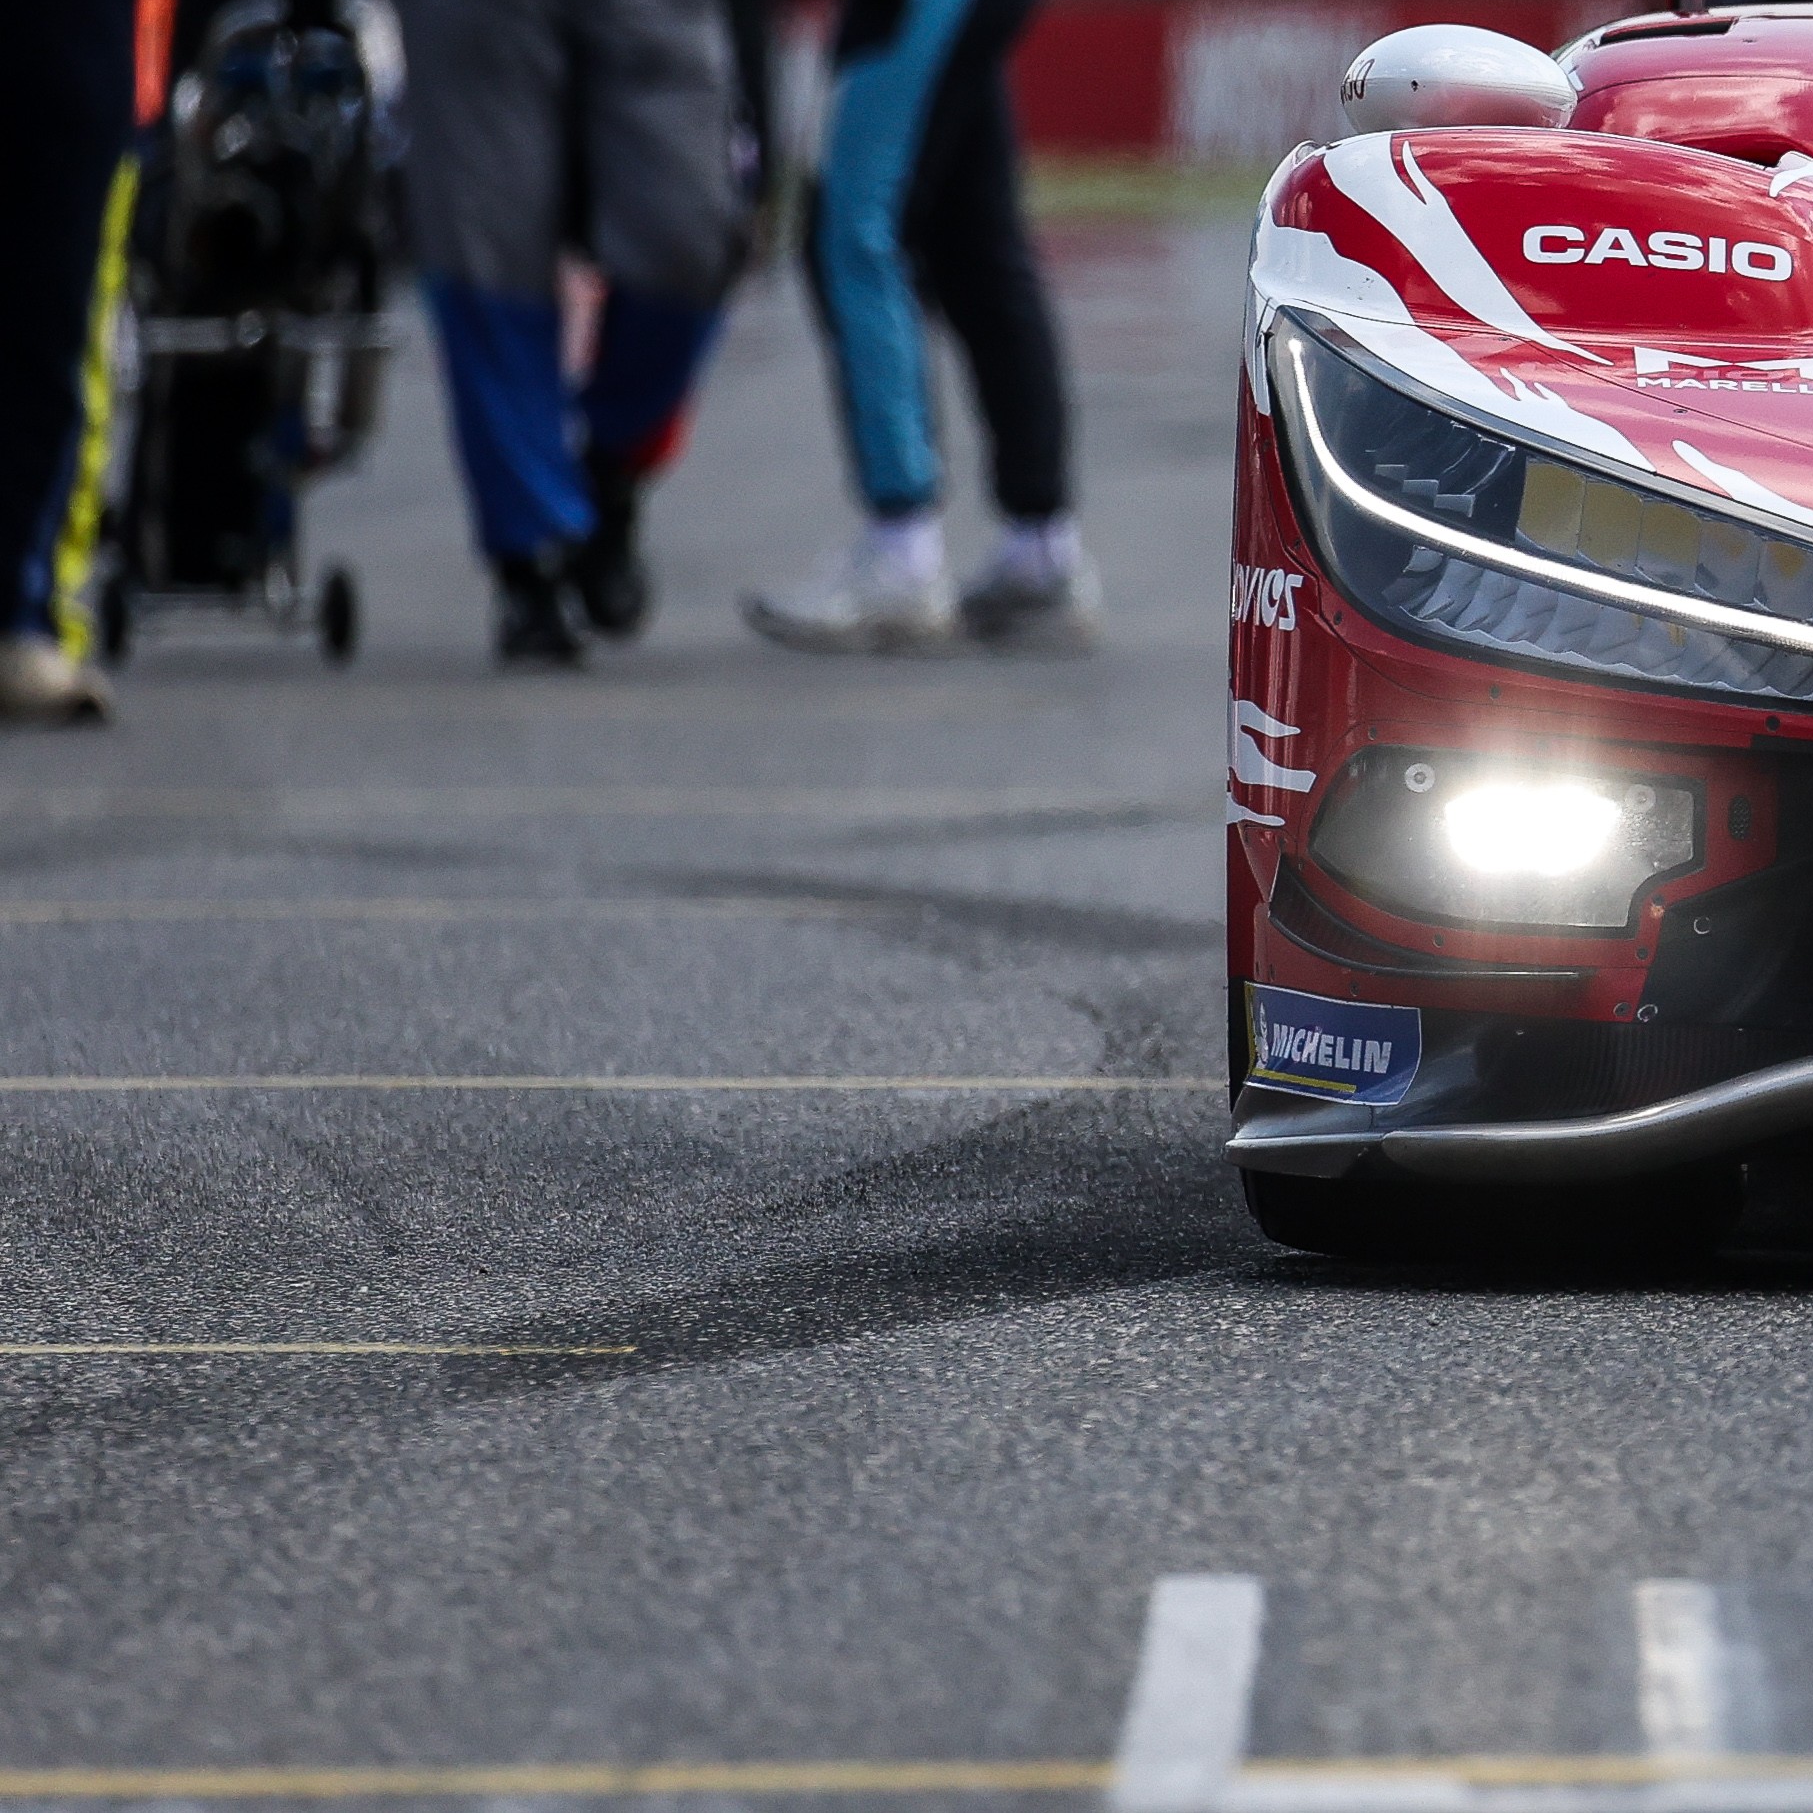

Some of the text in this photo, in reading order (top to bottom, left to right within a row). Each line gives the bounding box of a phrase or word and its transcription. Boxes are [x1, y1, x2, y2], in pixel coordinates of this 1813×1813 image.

[1521, 225, 1794, 282] CASIO
[1233, 558, 1305, 631] DVICS
[1270, 1023, 1393, 1074] MICHELIN
